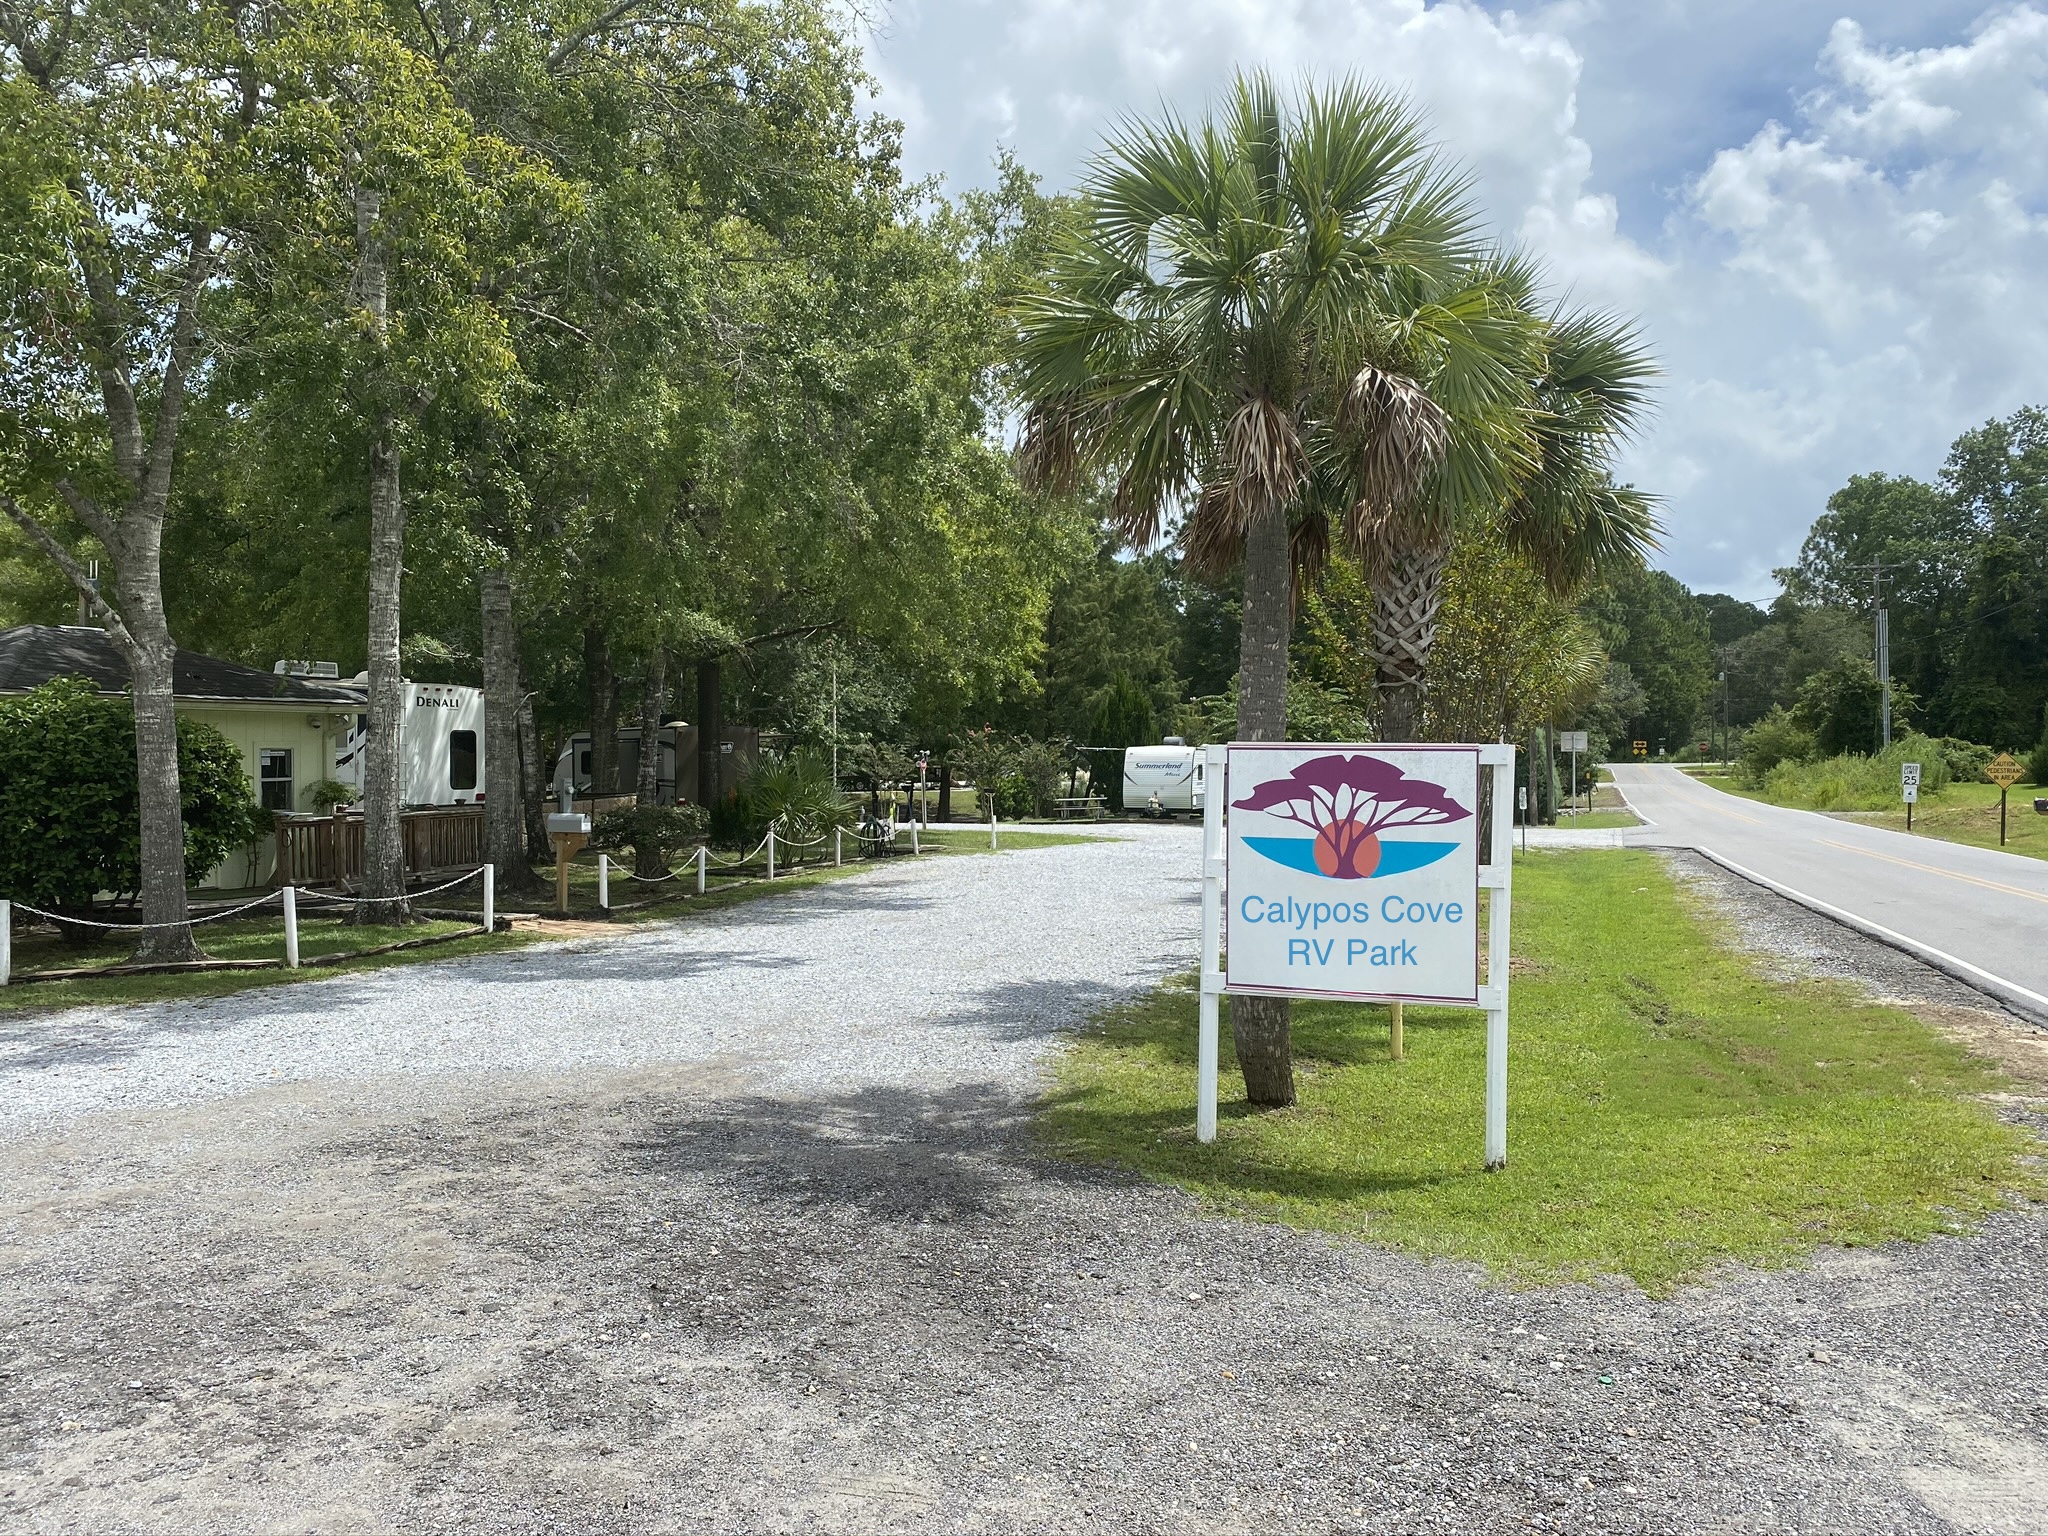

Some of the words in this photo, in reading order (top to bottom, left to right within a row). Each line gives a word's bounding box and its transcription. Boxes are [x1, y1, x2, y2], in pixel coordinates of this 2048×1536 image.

[416, 696, 459, 708] DENALI
[1903, 775, 1917, 785] 25
[1240, 894, 1370, 930] Calypos
[1380, 894, 1464, 924] Cove
[1287, 938, 1335, 966] RV
[1346, 938, 1418, 967] Park
